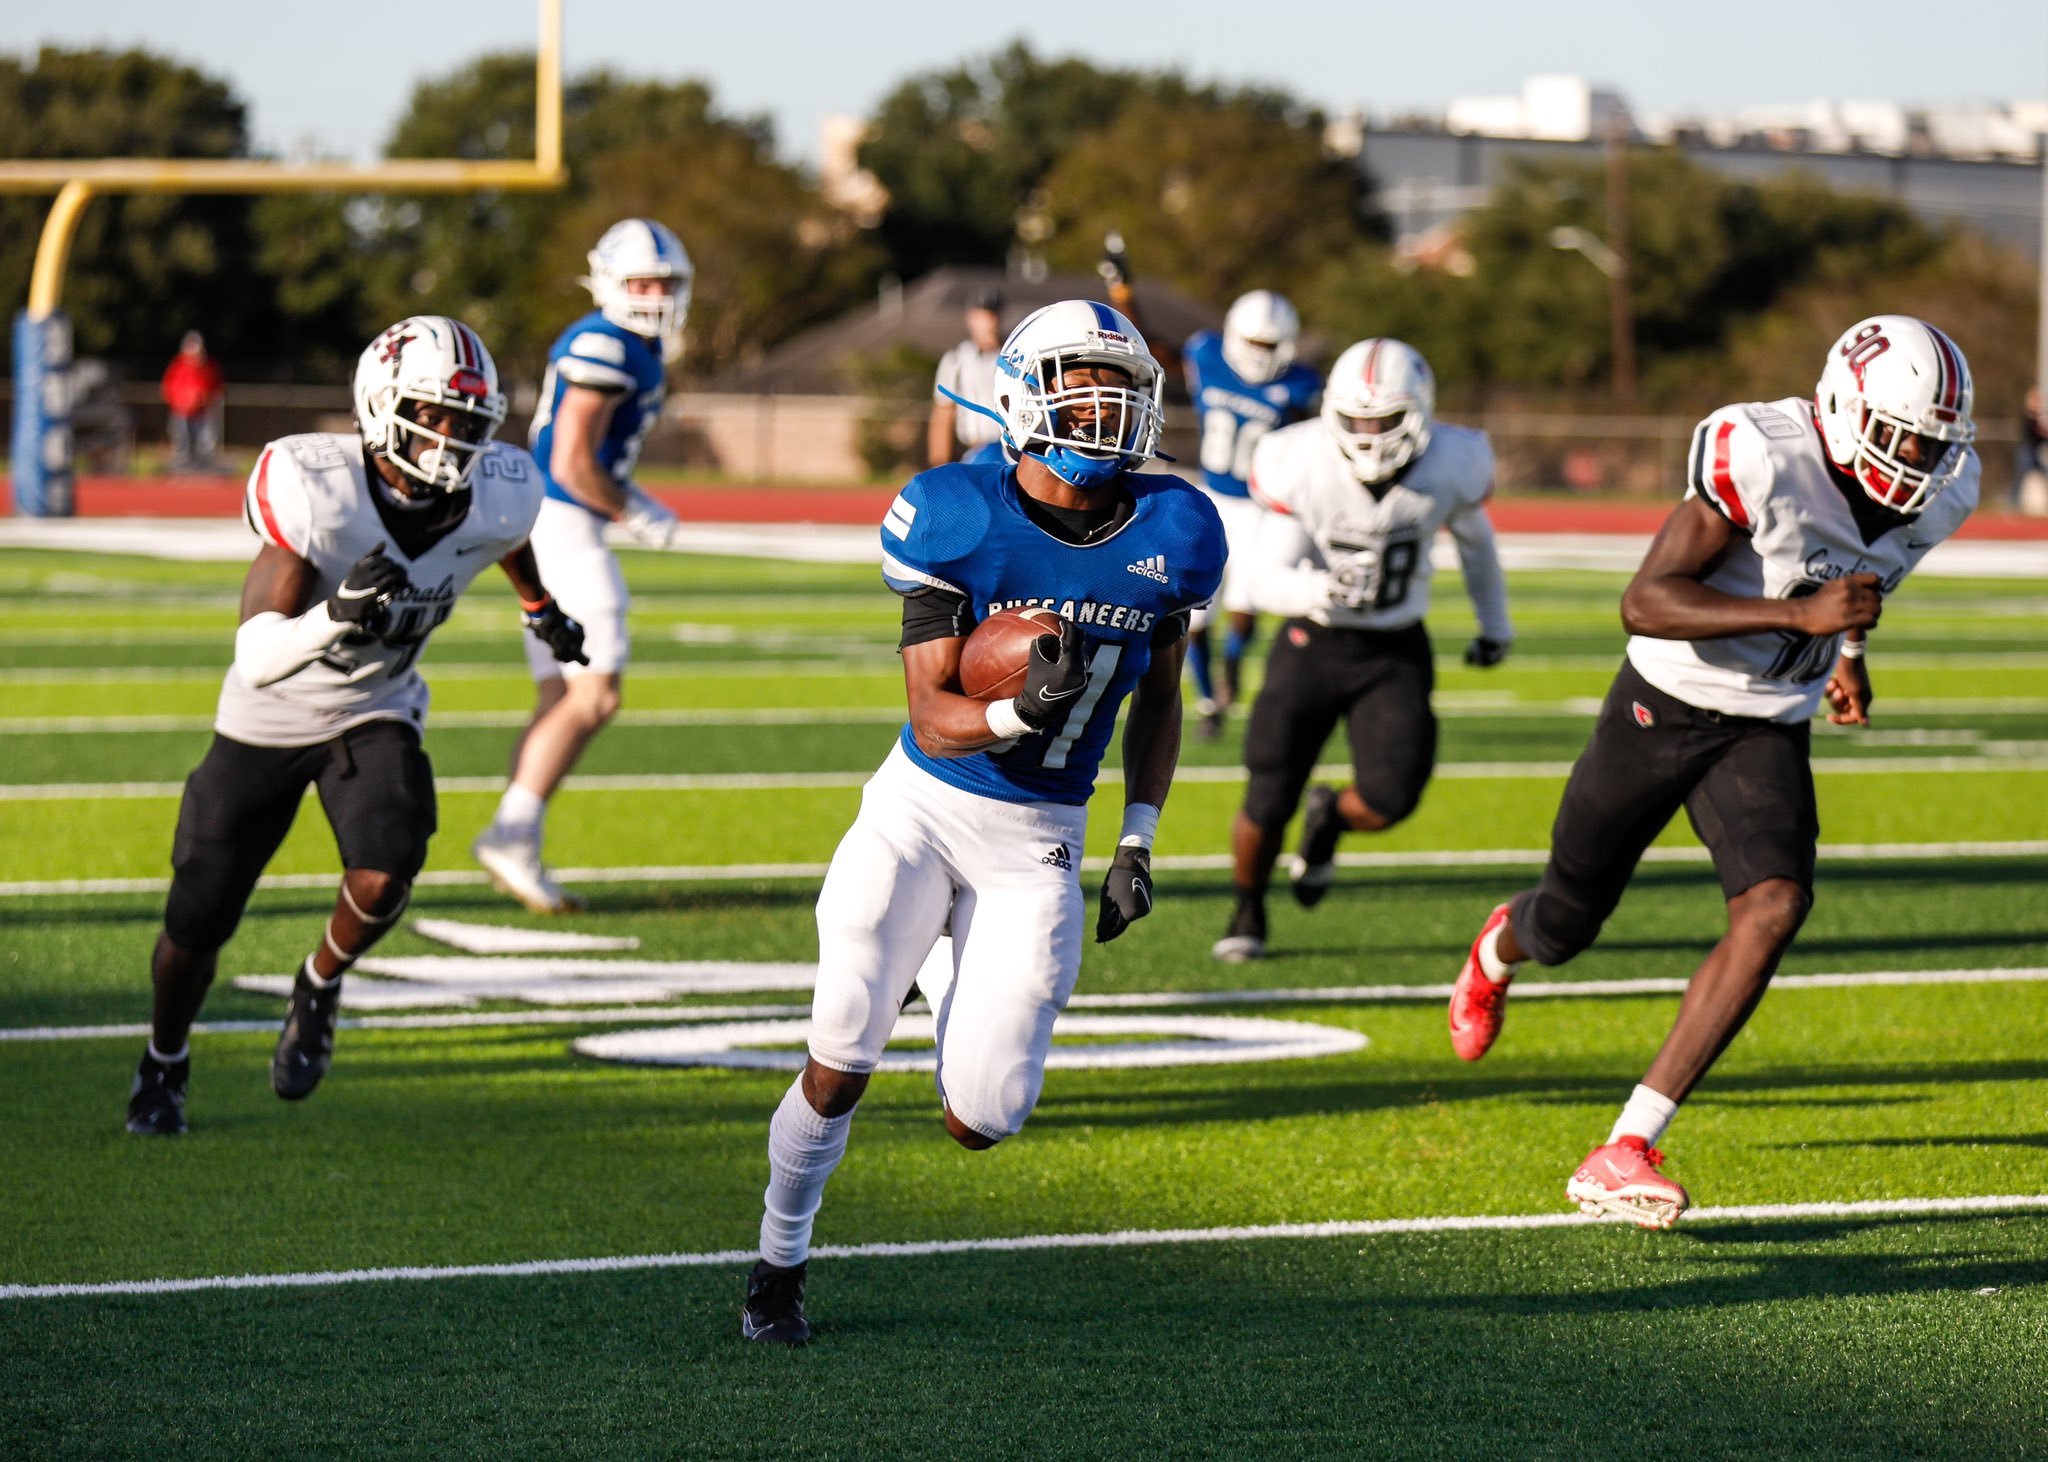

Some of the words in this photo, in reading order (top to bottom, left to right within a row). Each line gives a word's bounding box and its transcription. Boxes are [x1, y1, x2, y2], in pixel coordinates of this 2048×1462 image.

[1097, 331, 1128, 343] Riddell
[1841, 324, 1891, 369] 90
[1126, 563, 1169, 584] adidas
[1041, 855, 1073, 872] adidas
